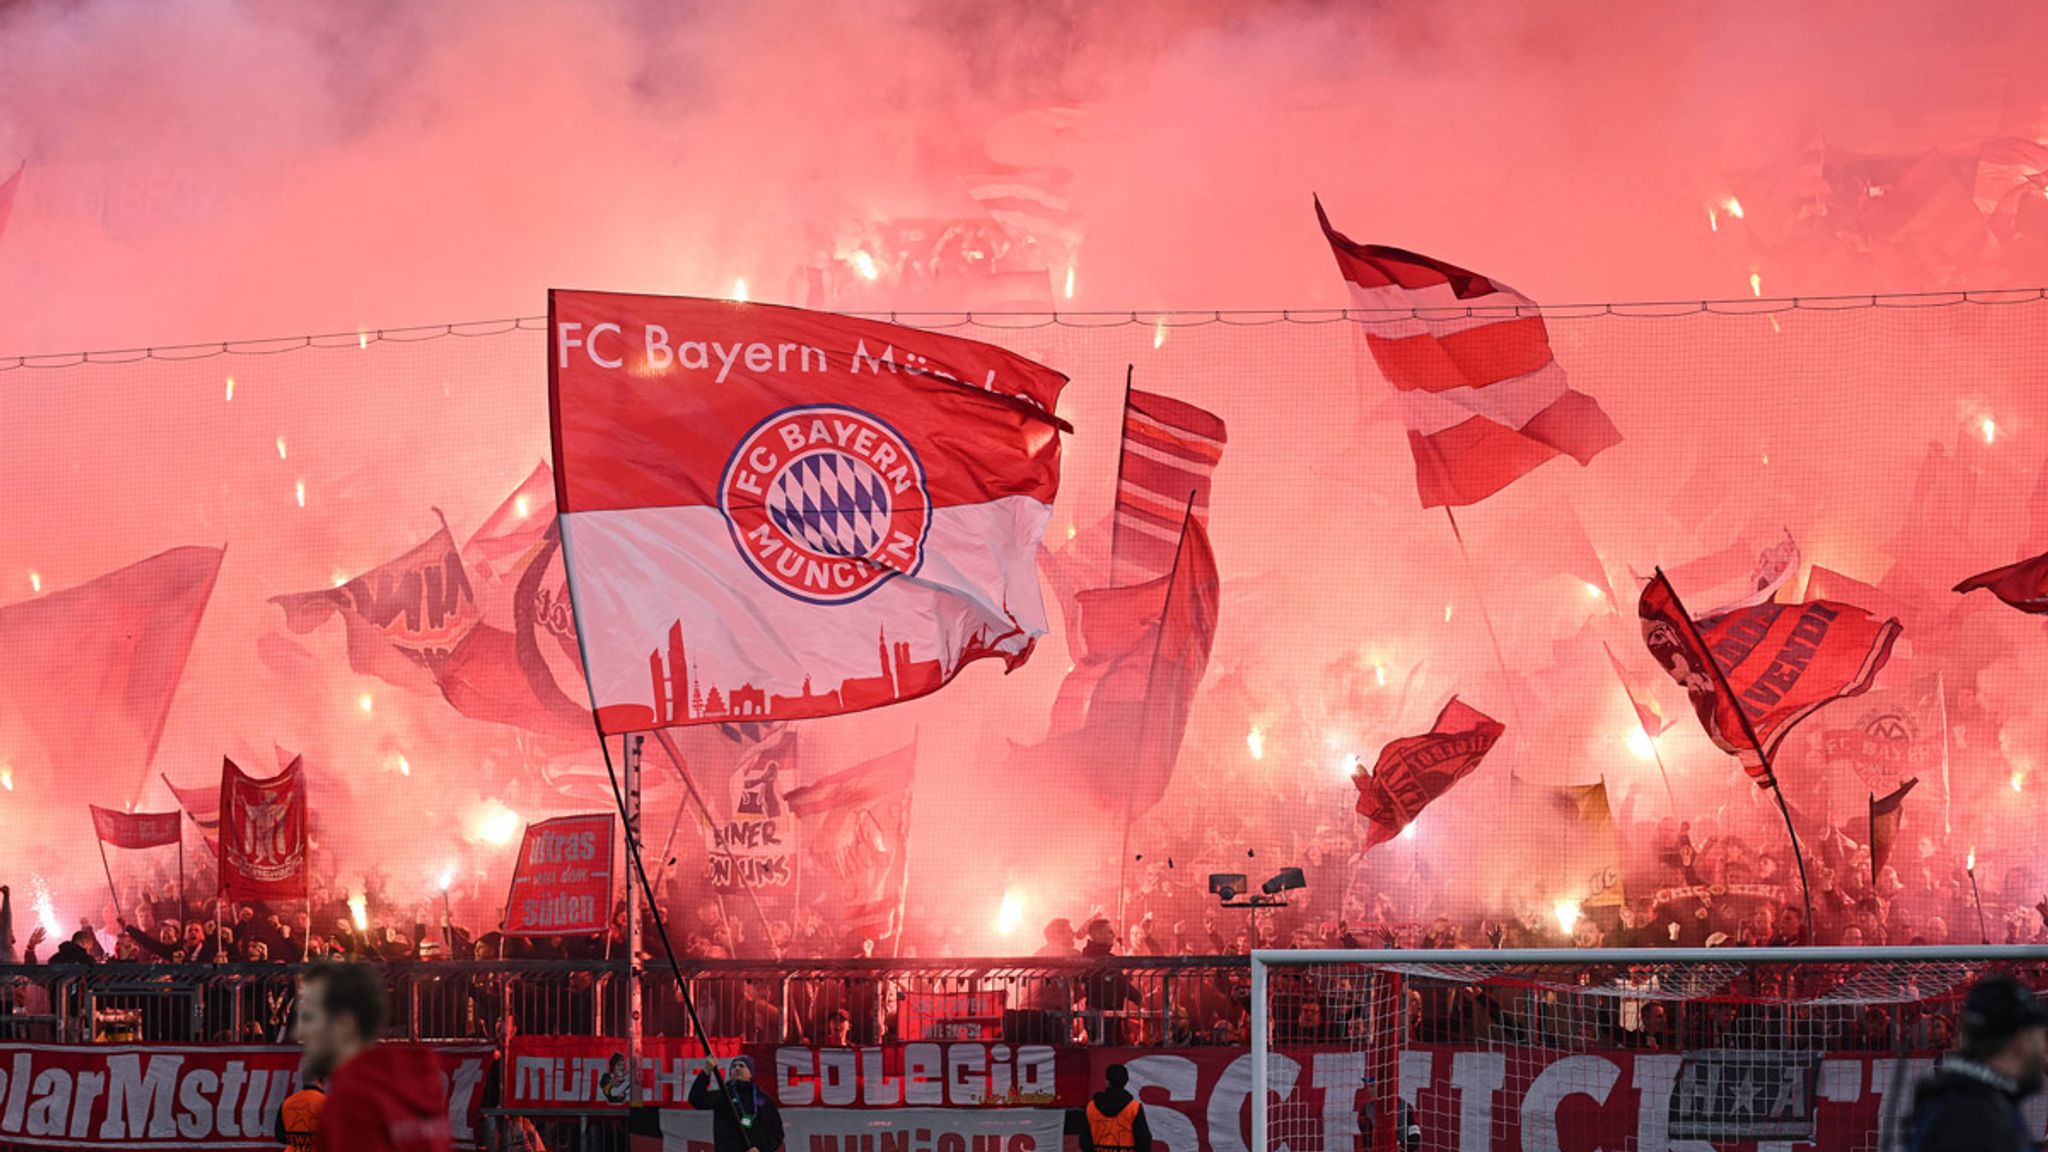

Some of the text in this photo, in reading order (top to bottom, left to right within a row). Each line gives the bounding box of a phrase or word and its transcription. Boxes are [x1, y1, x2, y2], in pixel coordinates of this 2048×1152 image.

[558, 323, 623, 368] FC
[645, 325, 828, 384] Bayern
[736, 419, 911, 495] FC BAYERN
